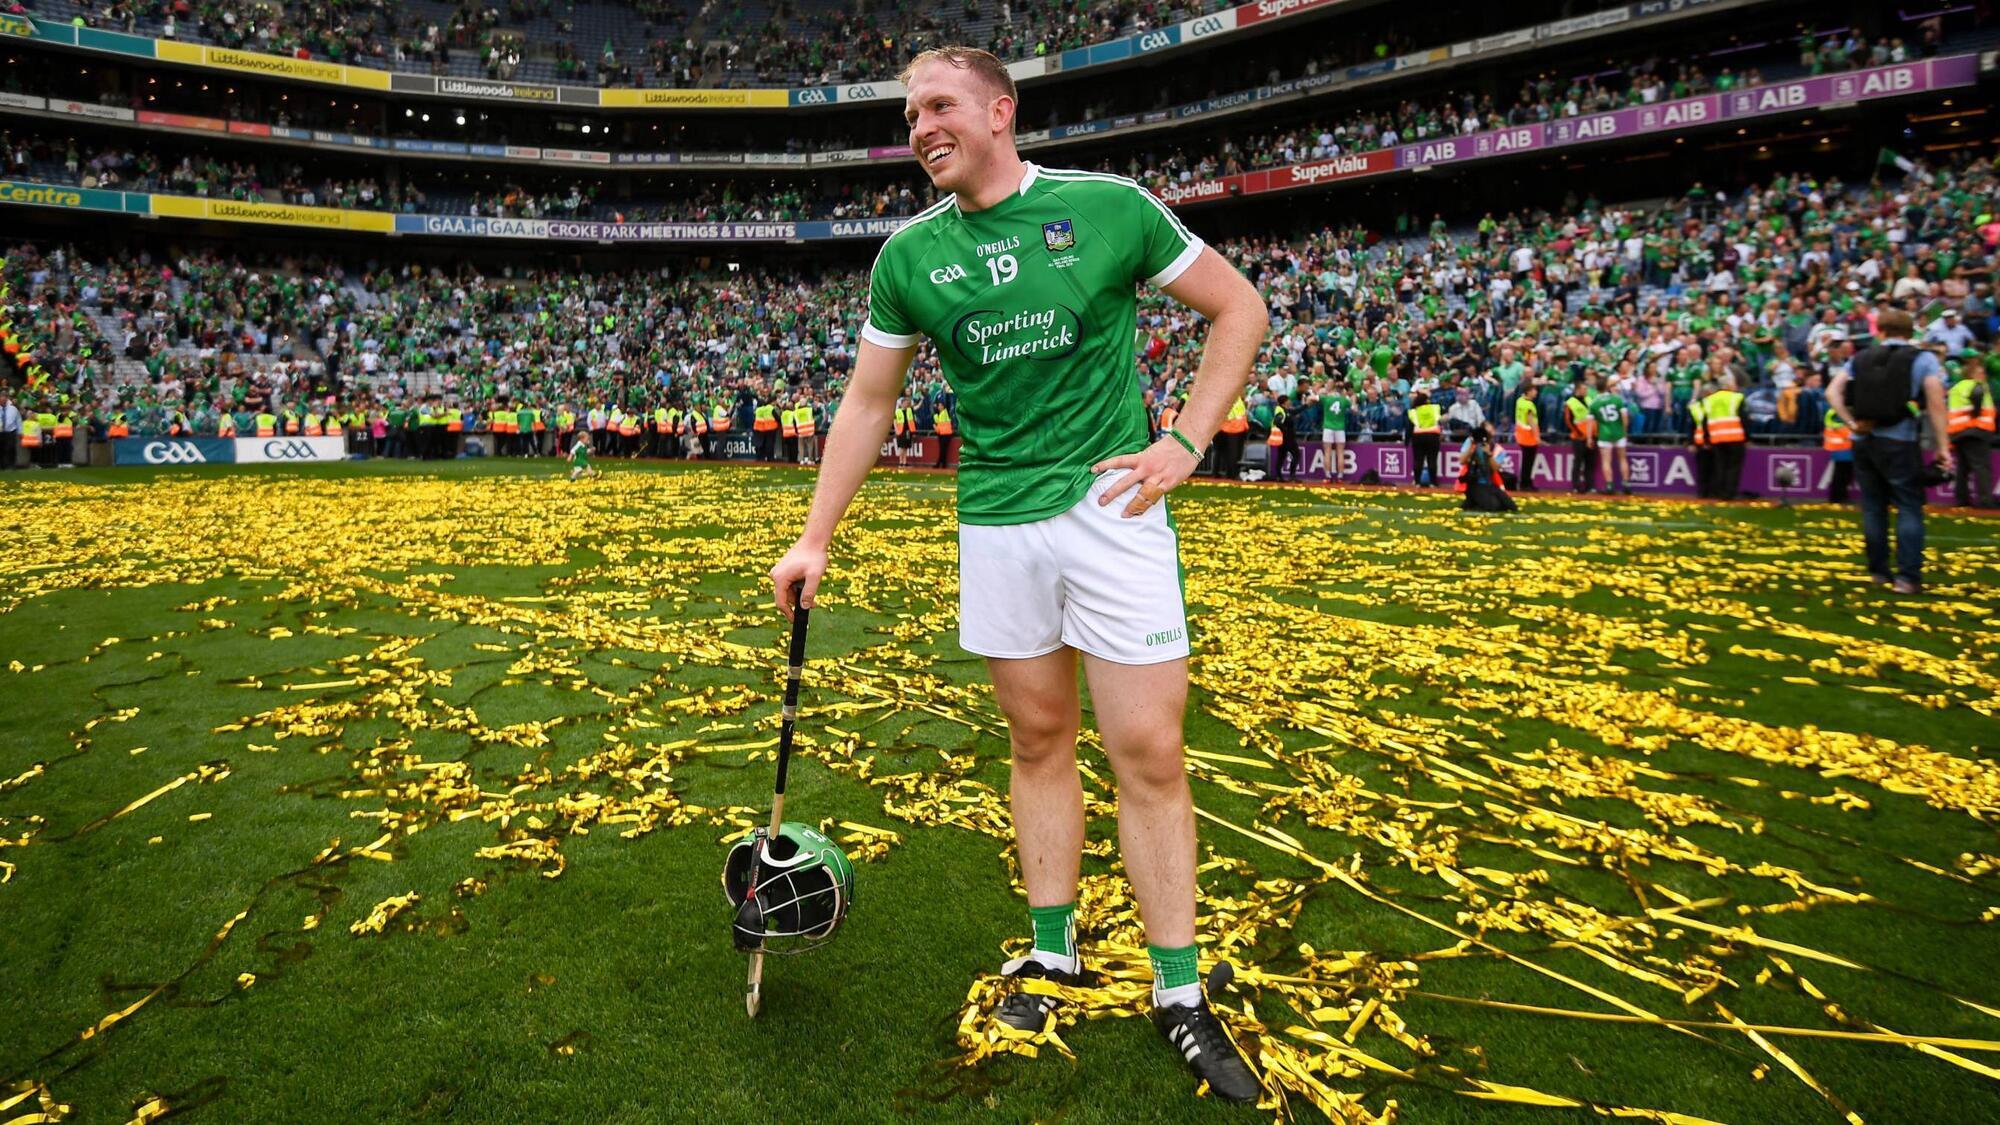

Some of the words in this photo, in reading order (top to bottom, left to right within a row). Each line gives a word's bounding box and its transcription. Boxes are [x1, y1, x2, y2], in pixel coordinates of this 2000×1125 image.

[1862, 68, 1914, 95] AIB
[1183, 103, 1202, 117] GAA
[1208, 93, 1249, 111] MUSEUM
[1759, 85, 1806, 110] AIB
[1664, 101, 1706, 124] AIB
[1066, 124, 1096, 136] GAA.ie
[1576, 116, 1616, 138] AIB
[1496, 130, 1533, 151] AIB
[1422, 142, 1456, 162] AIB
[1291, 156, 1367, 182] SuperValu
[0, 183, 80, 206] Centra
[1161, 180, 1223, 205] SuperValu
[429, 217, 486, 234] GAA.ie
[491, 219, 546, 236] GAA.ie
[549, 223, 599, 238] CROKE
[602, 223, 639, 238] PARK
[641, 225, 718, 239] MEETINGS
[720, 225, 731, 238] &
[735, 224, 795, 238] EVENTS
[832, 222, 864, 235] GAA
[867, 220, 906, 234] MUS
[976, 235, 1020, 258] O'NEILLS
[985, 254, 1019, 286] 19
[967, 308, 1055, 344] Sporting
[982, 325, 1074, 366] Limerick
[1329, 400, 1341, 415] 4
[1600, 403, 1618, 422] 15
[1146, 627, 1182, 647] O'NEILLS
